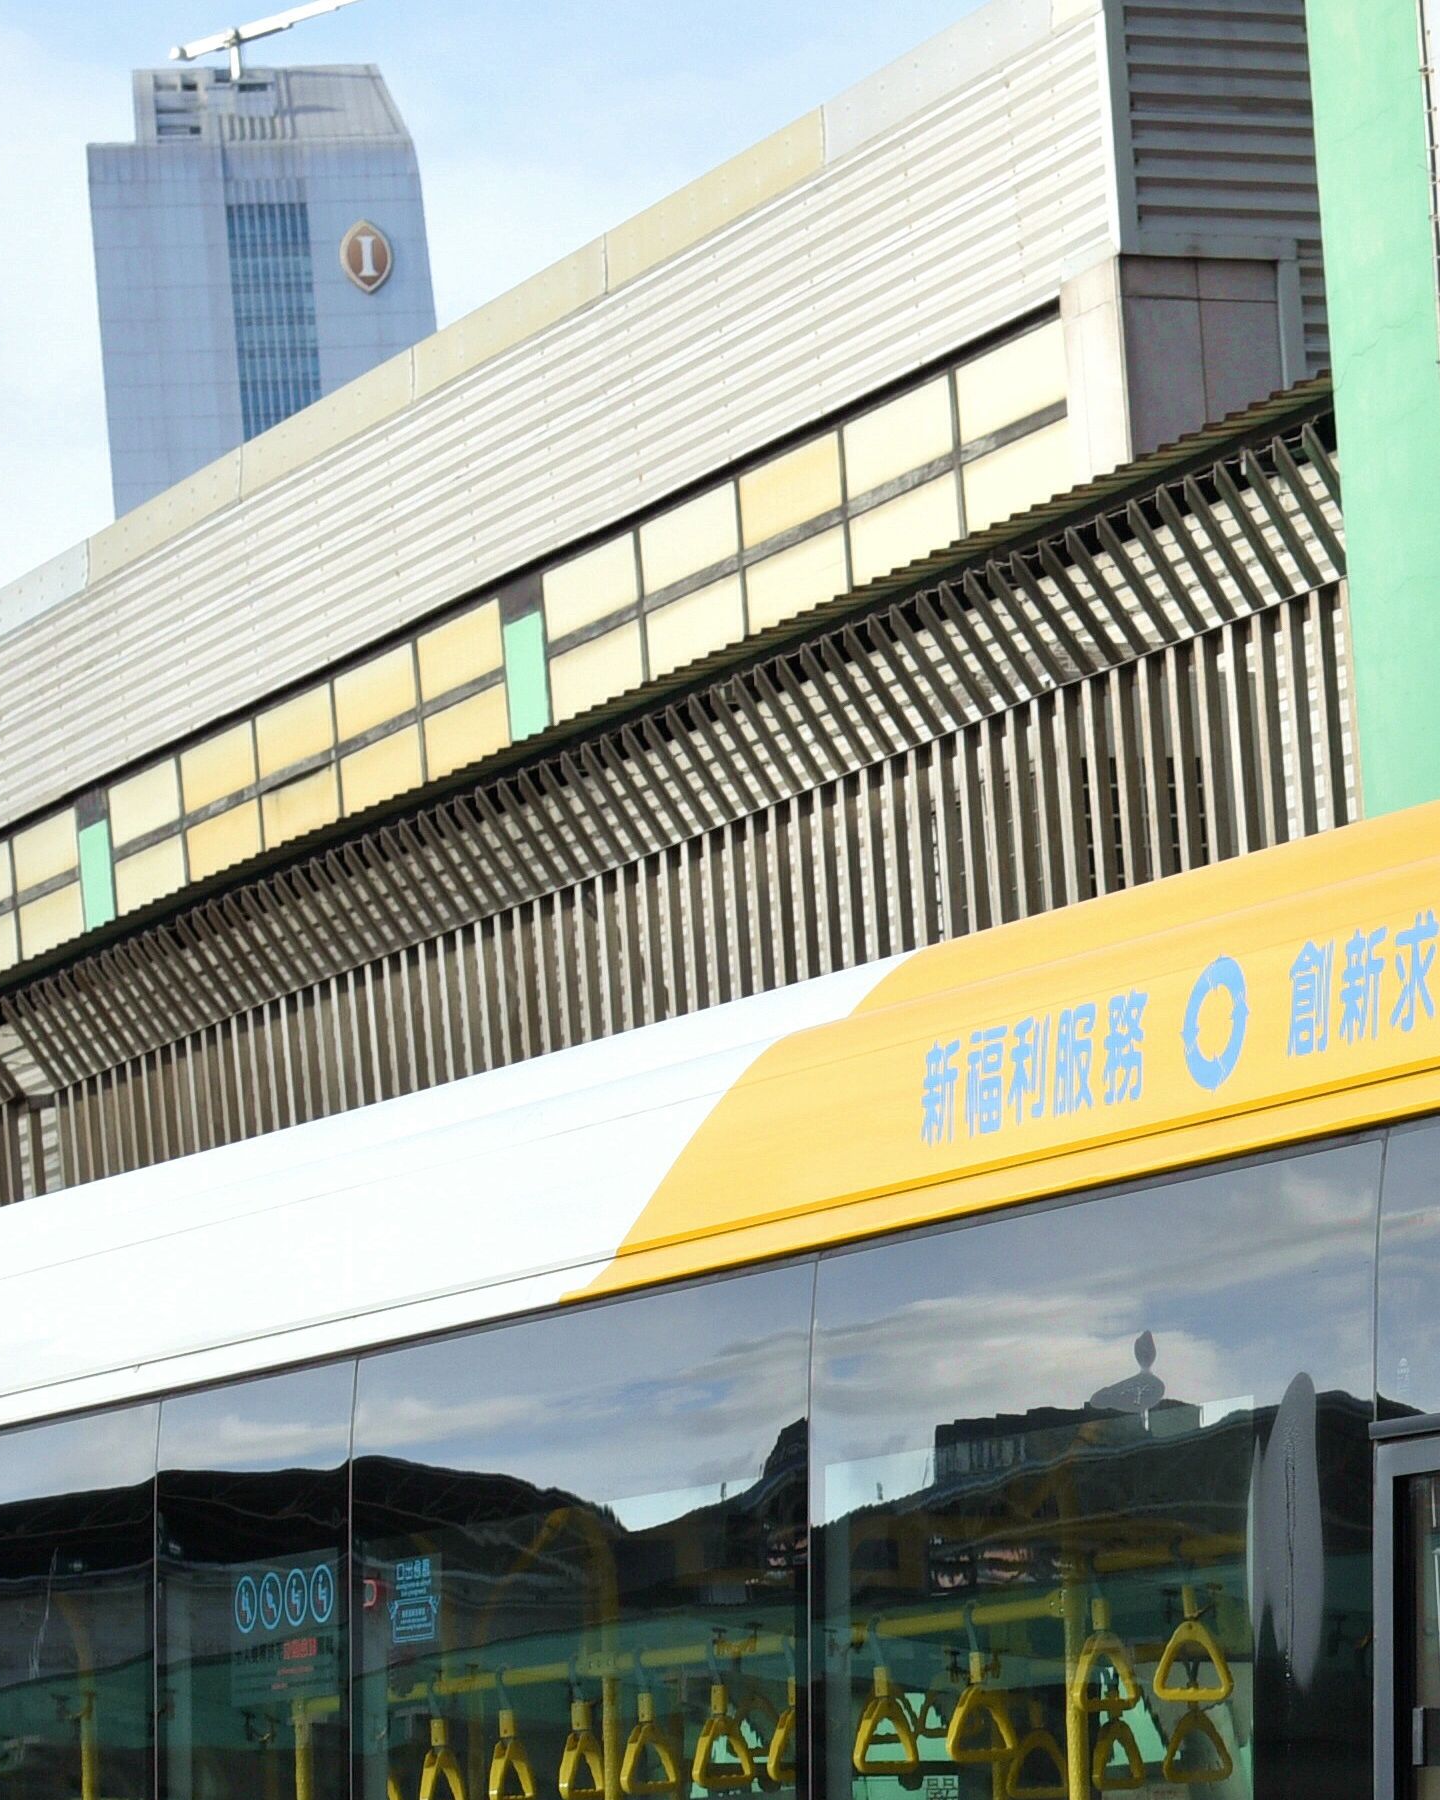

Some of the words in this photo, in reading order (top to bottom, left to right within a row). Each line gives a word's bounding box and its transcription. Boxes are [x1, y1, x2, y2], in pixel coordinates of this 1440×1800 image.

[920, 989, 1149, 1146] 新福利服務
